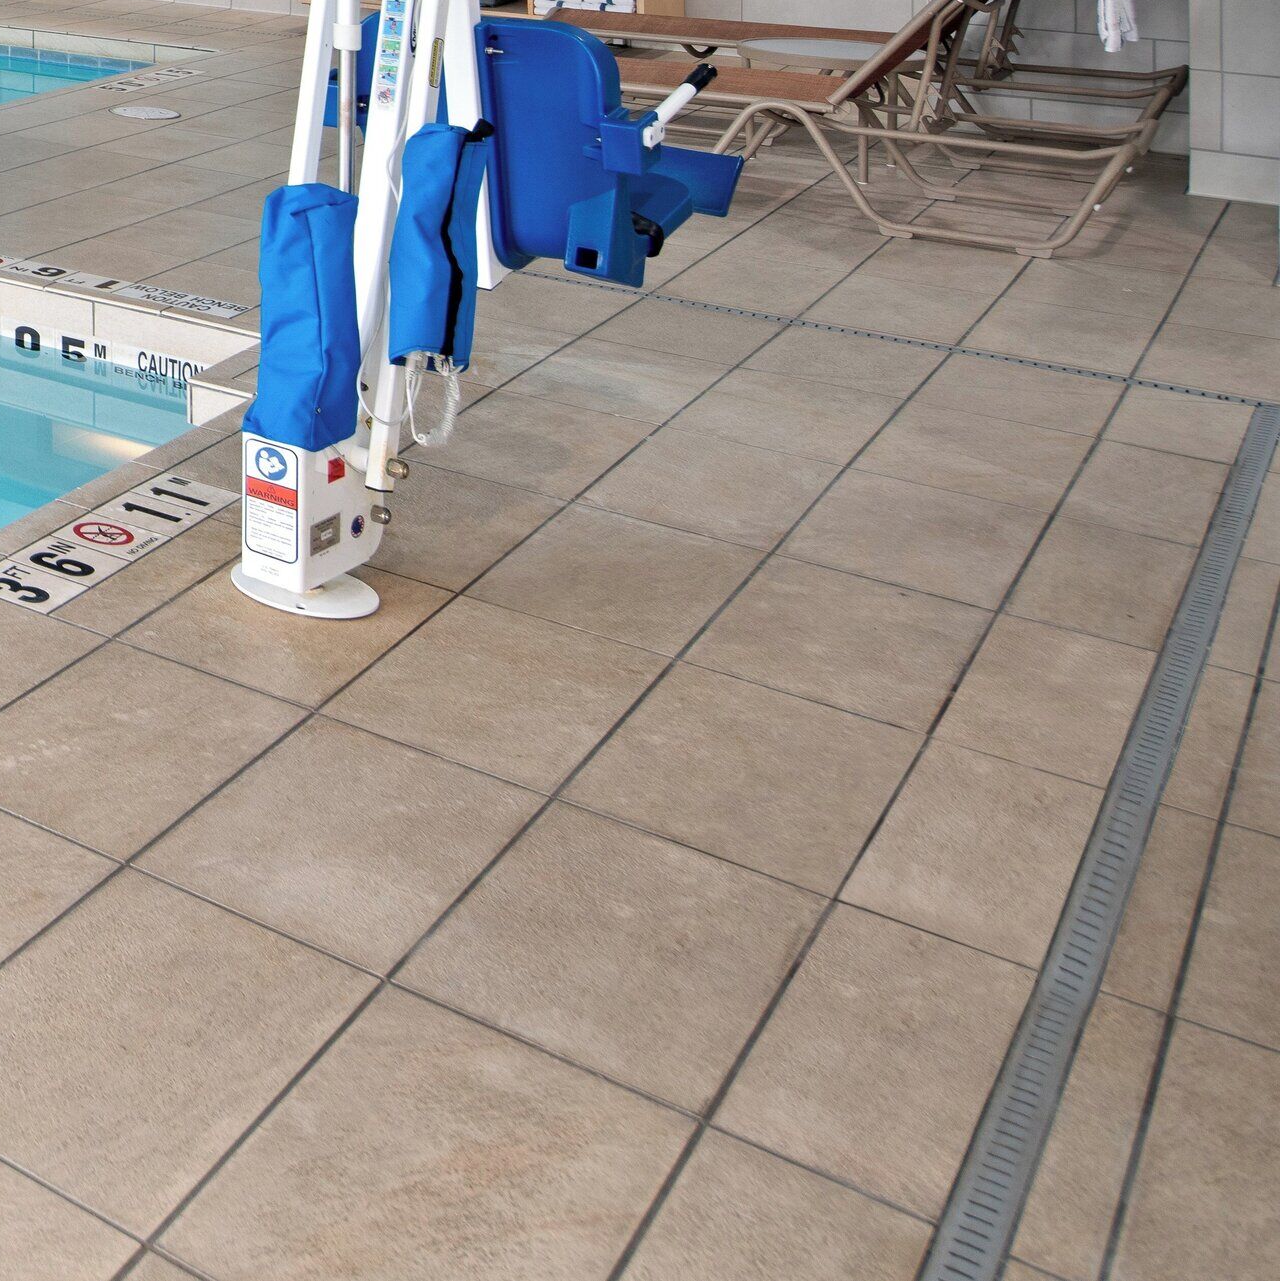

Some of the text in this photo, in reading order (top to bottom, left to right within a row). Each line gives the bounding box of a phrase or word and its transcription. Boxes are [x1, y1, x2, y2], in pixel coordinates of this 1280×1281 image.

[94, 279, 120, 290] 1
[132, 284, 250, 312] BENCH BELOW
[141, 294, 212, 312] CAUTION
[94, 344, 107, 359] M
[167, 476, 191, 487] M
[248, 487, 295, 507] WARNING
[47, 540, 78, 555] IN
[2, 564, 31, 580] FT
[29, 551, 96, 577] 6
